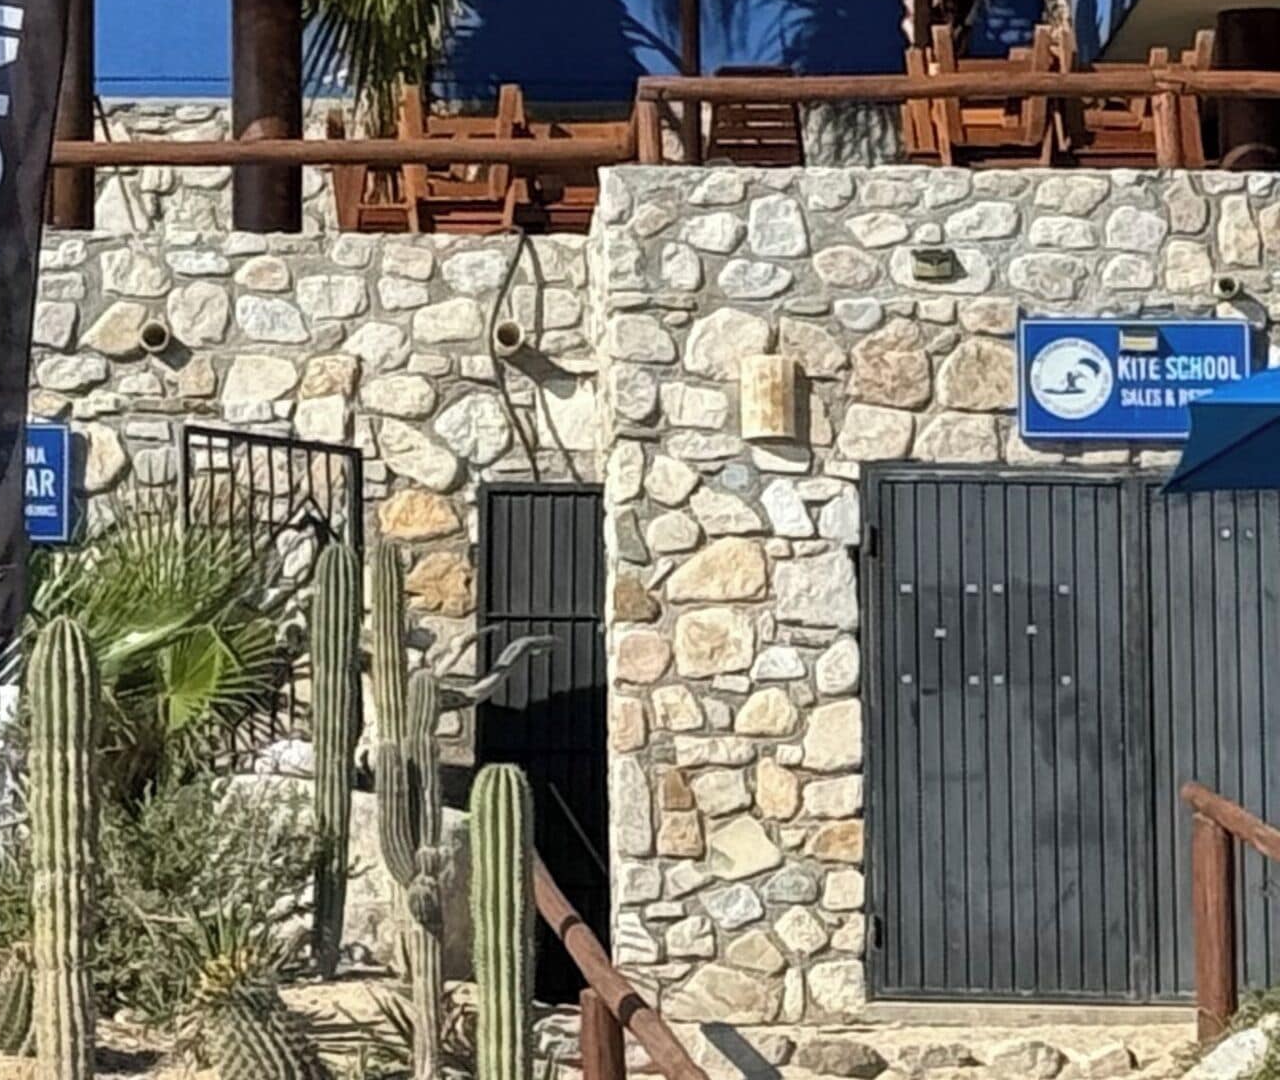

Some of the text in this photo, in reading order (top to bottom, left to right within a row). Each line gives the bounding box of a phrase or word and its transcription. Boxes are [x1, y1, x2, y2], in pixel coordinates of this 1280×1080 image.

[1117, 353, 1242, 382] KITE SCHOOL
[1120, 387, 1163, 408] SALES
[25, 445, 47, 465] NA
[24, 467, 56, 498] AR
